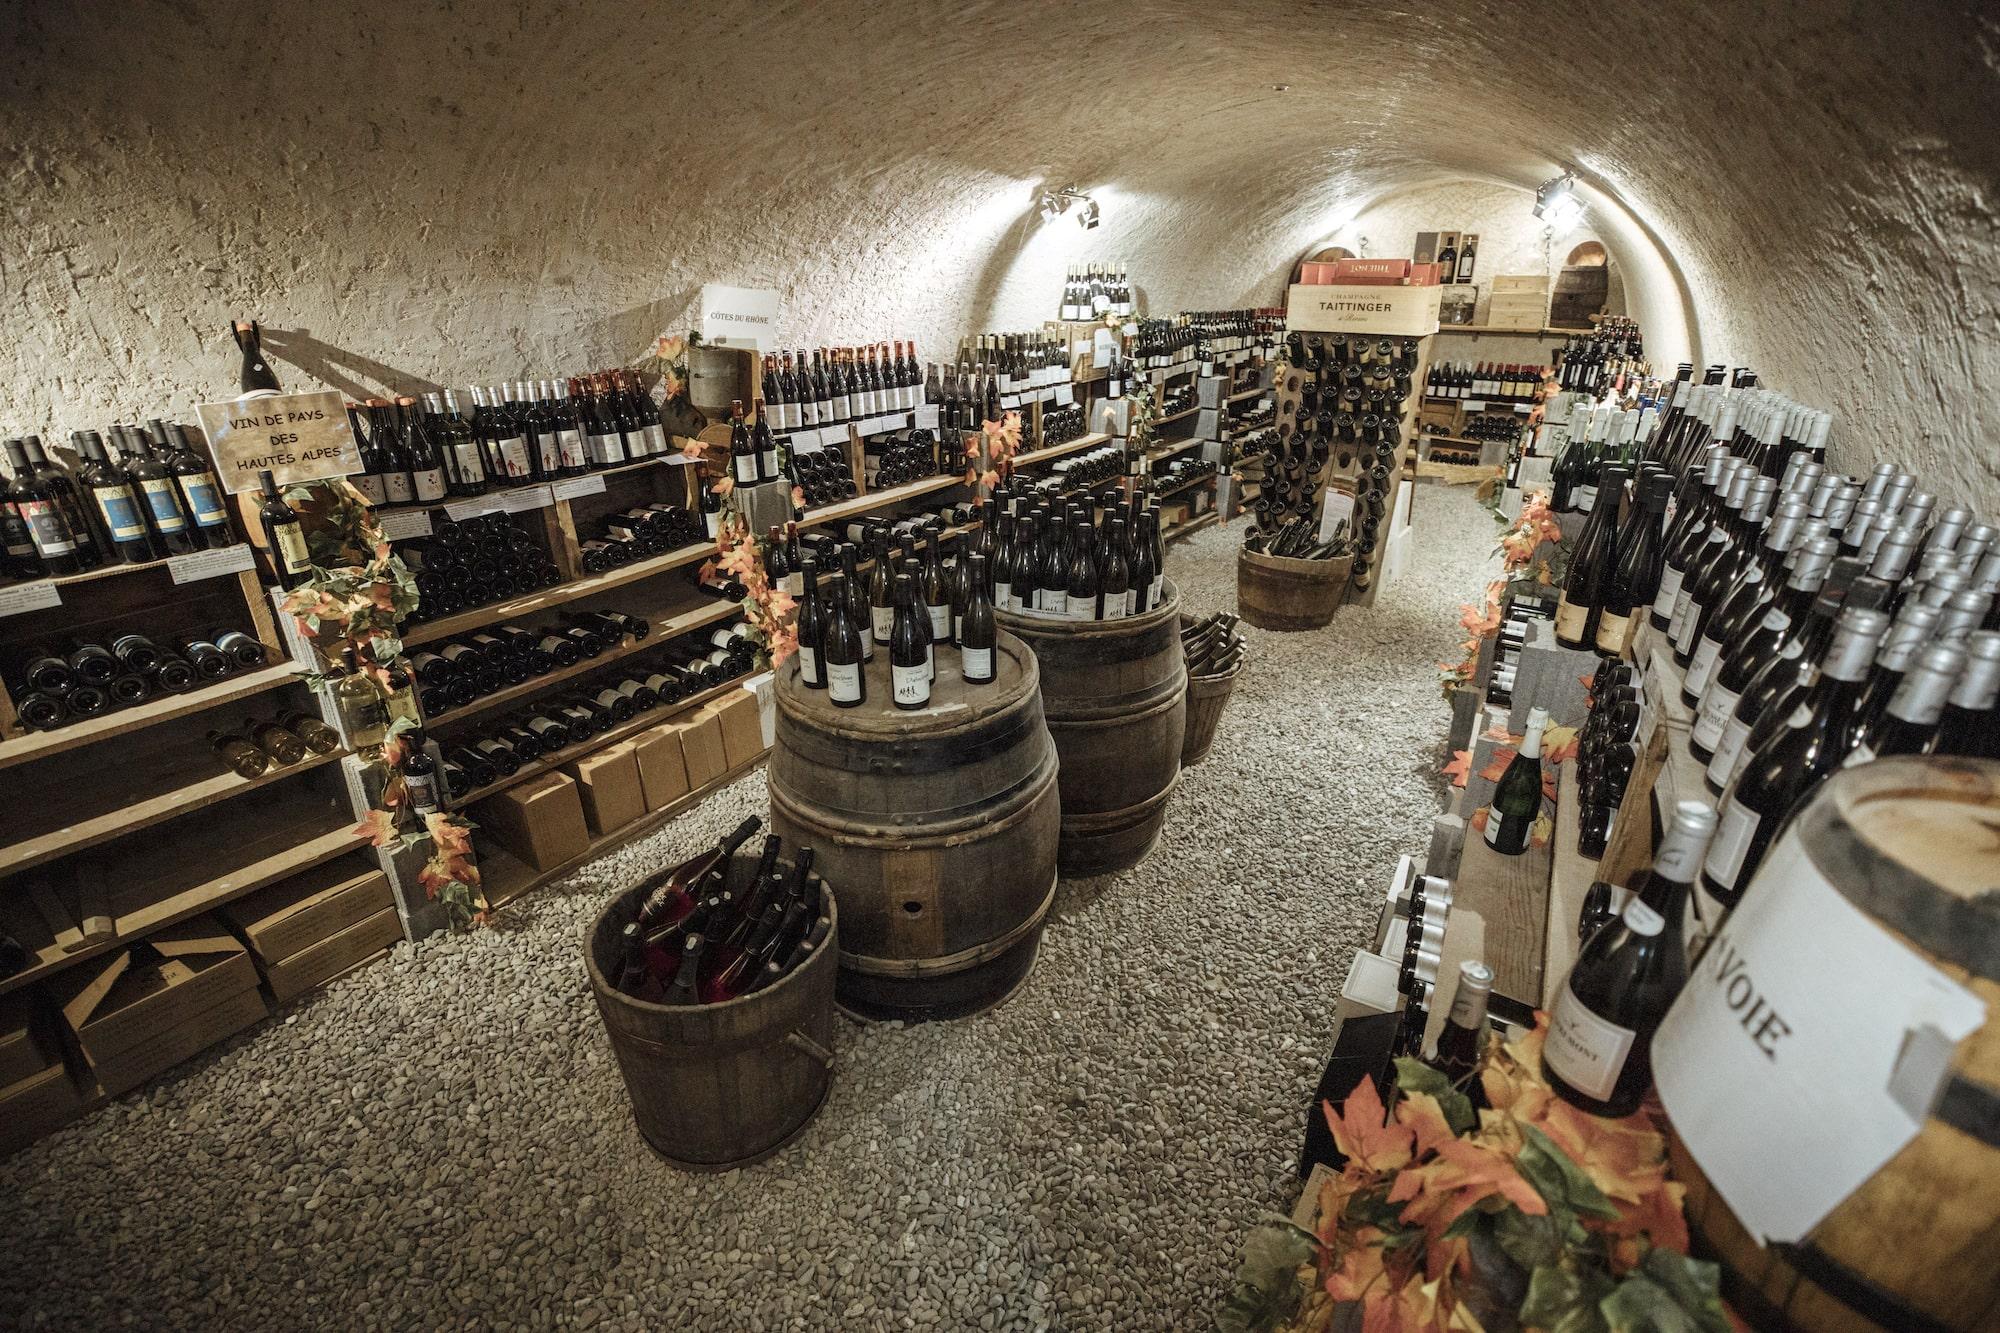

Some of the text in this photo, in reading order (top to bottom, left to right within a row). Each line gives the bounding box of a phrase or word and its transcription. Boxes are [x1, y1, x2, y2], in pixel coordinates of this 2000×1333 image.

[1319, 301, 1392, 312] TAITTINGER
[710, 311, 769, 325] CÔTES DU RHÔNE
[229, 410, 324, 430] VIN DE PAYS
[270, 433, 299, 446] DES
[236, 447, 342, 471] HAUTES ALPES
